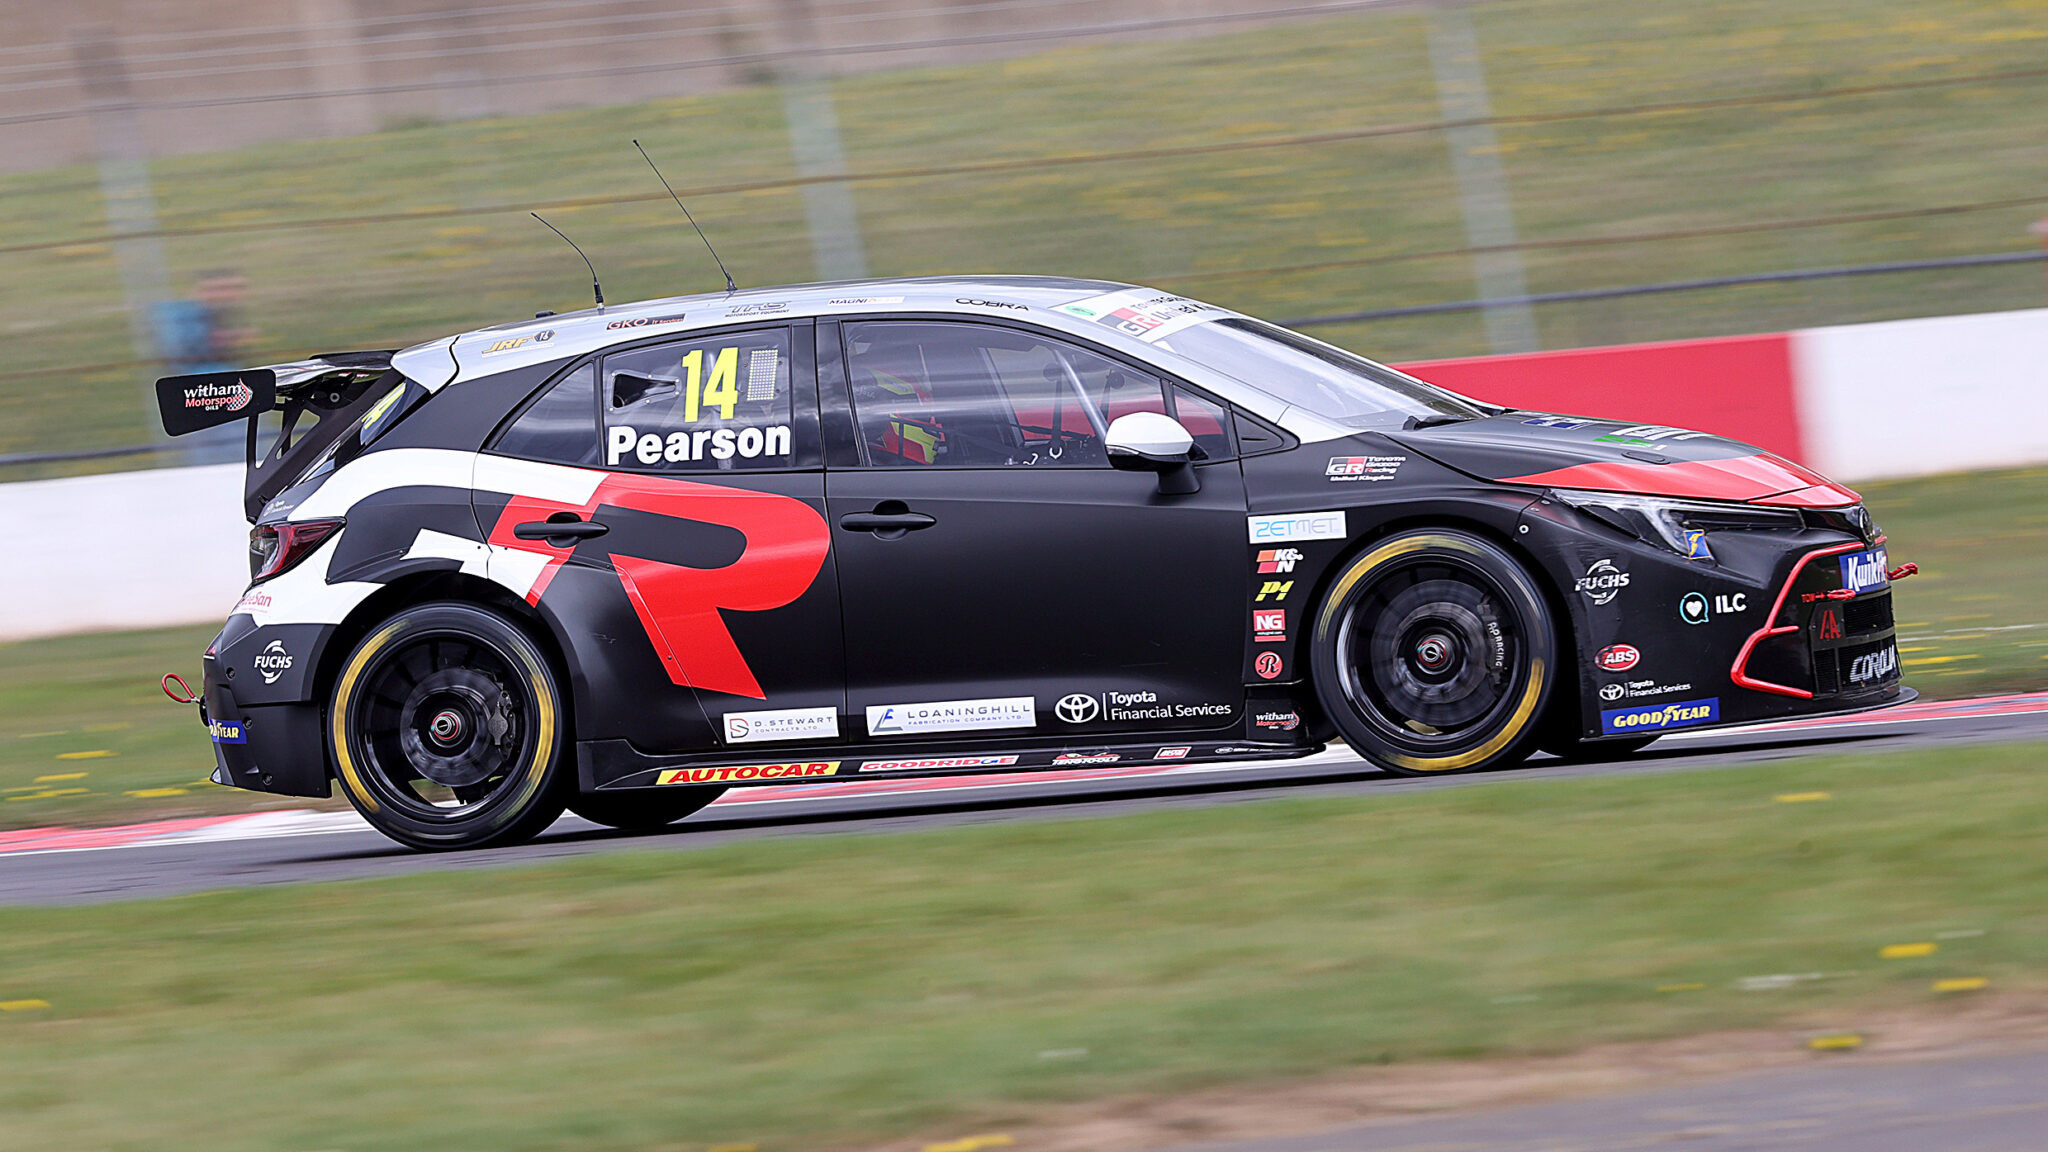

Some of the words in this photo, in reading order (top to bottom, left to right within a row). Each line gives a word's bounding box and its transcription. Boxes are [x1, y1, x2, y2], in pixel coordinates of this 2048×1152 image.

[955, 298, 1029, 311] COBRA
[608, 318, 649, 330] GKO
[481, 337, 529, 354] JRF
[184, 382, 242, 399] witham
[682, 346, 739, 423] 14
[607, 425, 792, 467] Pearson
[1575, 573, 1631, 592] FUCHS
[1715, 592, 1748, 614] ILC
[1256, 614, 1283, 630] NG
[254, 655, 293, 669] FUCHS
[1604, 651, 1636, 666] ABS
[1627, 680, 1655, 689] Toyota
[1629, 687, 1662, 698] Financial
[1662, 683, 1692, 693] Services
[1108, 691, 1157, 708] Toyota
[907, 705, 1031, 719] LOANINGHILL
[1110, 706, 1173, 722] Financial
[1174, 704, 1233, 718] Services
[1255, 712, 1294, 721] witham
[1613, 705, 1711, 728] GOODYEAR
[908, 718, 961, 726] FABRICATION
[862, 757, 1015, 773] GOODRIDGE
[667, 763, 831, 785] AUTOCAR
